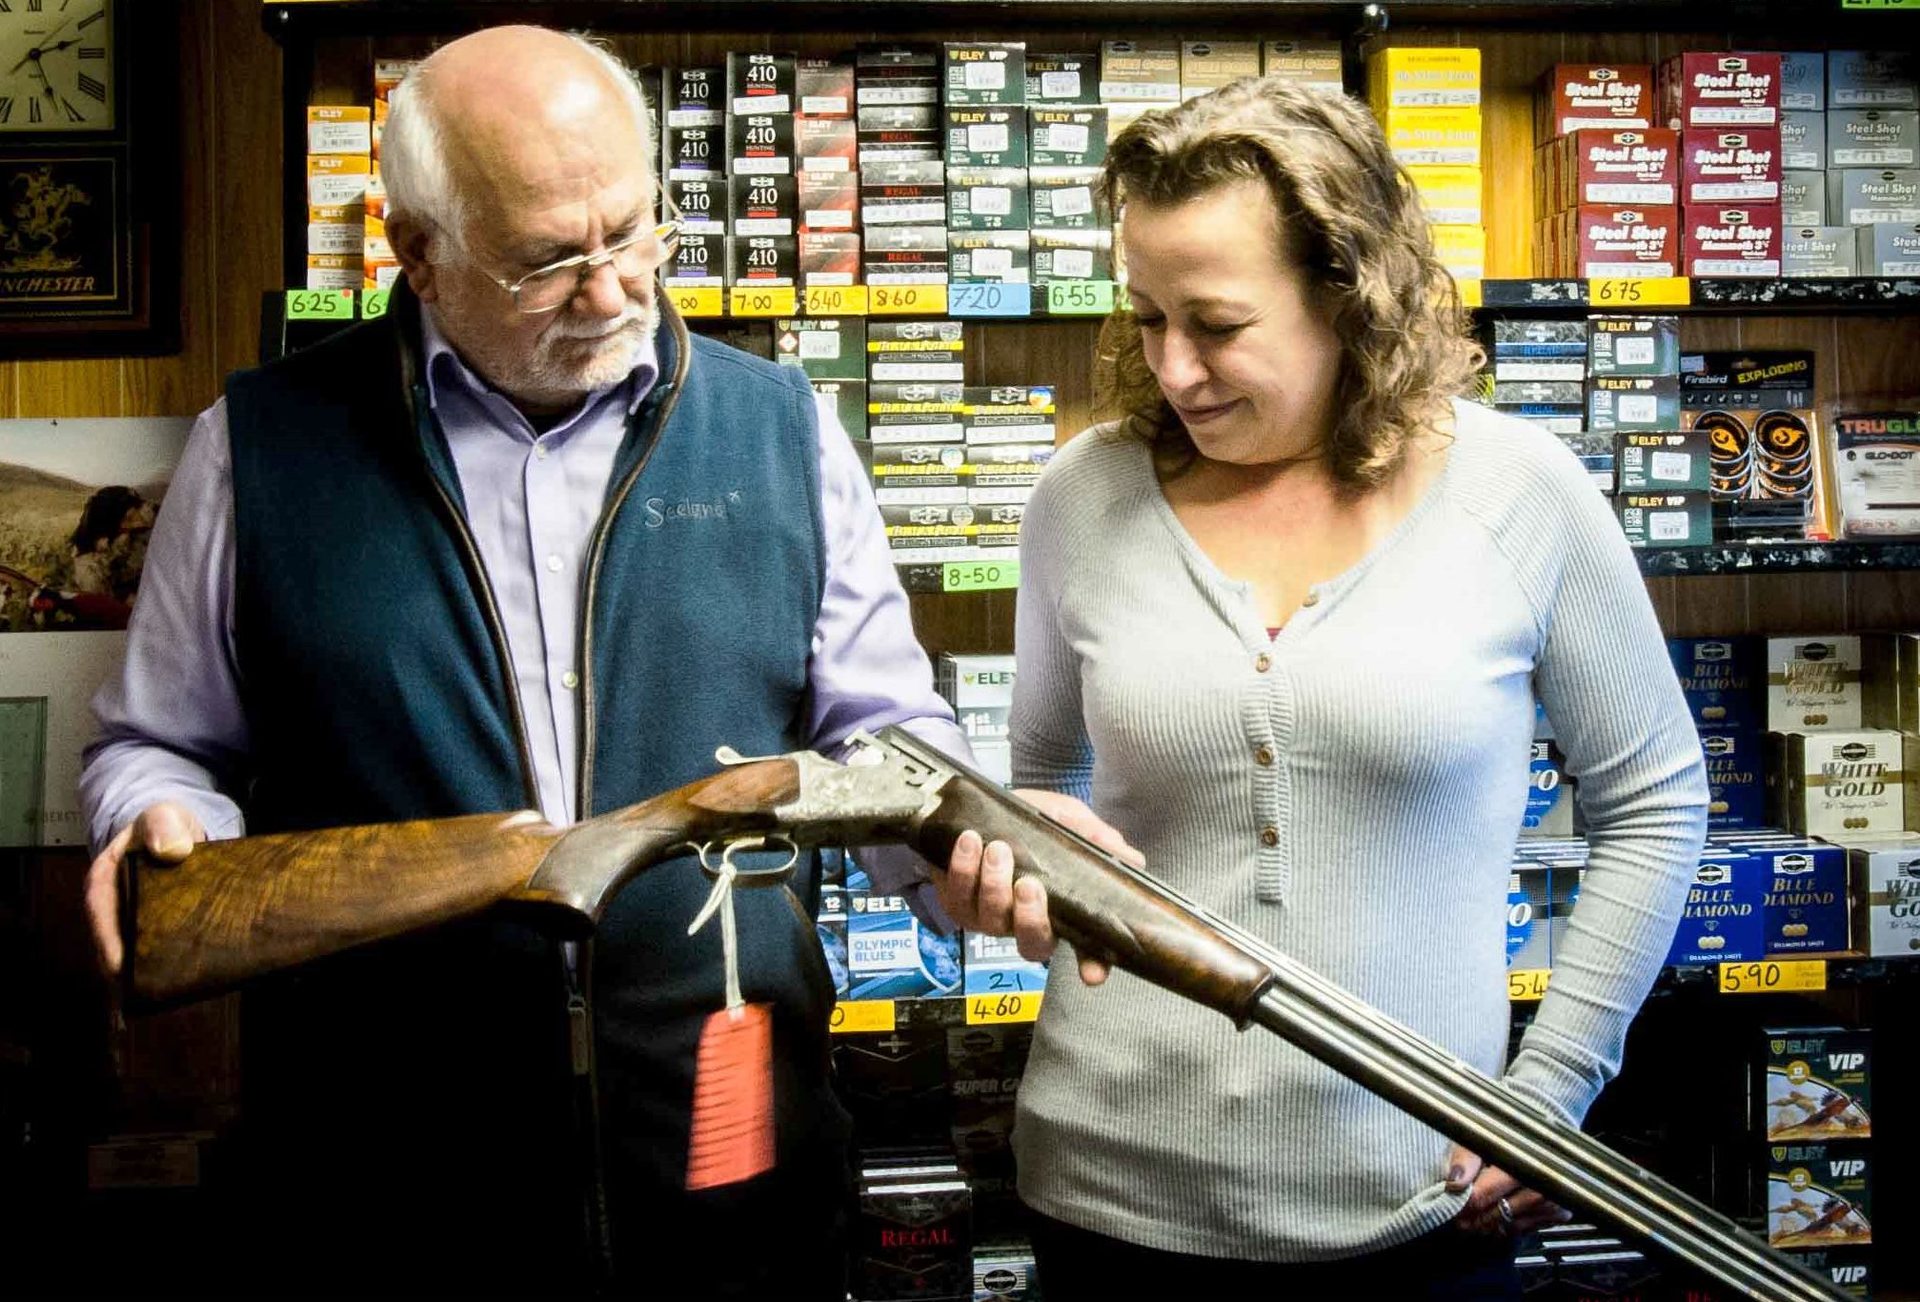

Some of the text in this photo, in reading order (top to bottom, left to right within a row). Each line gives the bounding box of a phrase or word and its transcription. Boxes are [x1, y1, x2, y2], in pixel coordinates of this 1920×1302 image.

[960, 51, 1008, 60] ELEY VIP
[1035, 63, 1081, 71] ELEY VIP
[1694, 73, 1771, 87] Steel Shot
[1565, 82, 1642, 97] Steel Shot
[961, 113, 1009, 122] ELEY VIP
[1045, 113, 1092, 122] ELEY VIP
[1782, 125, 1806, 135] Shot
[1846, 123, 1901, 133] Steel Shot
[1589, 147, 1668, 162] Steel Shot
[1695, 150, 1772, 164] Steel Shot
[884, 187, 921, 197] REGAL
[1782, 184, 1806, 194] Shot
[1861, 184, 1917, 194] Steel Shot
[1588, 225, 1667, 240] Steel Shot
[1695, 226, 1773, 240] Steel Shot
[1811, 241, 1837, 251] Shot
[3, 276, 94, 292] NCHESTER
[1608, 322, 1653, 331] ELEY VIP
[1736, 360, 1807, 385] EXPLODING
[1608, 380, 1653, 389] ELEY VIP
[1685, 375, 1728, 385] Firebird
[820, 384, 839, 393] VIP
[1638, 436, 1685, 446] ELEY VIP
[1638, 497, 1685, 506] ELEY VIP
[977, 672, 1016, 685] ELE
[1708, 759, 1736, 771] LUE
[1822, 762, 1888, 778] WHITE
[1823, 781, 1885, 798] GOLD
[1773, 878, 1817, 892] BLUE
[1689, 889, 1734, 903] BLUE
[1684, 904, 1752, 918] IAMOND
[854, 938, 912, 951] OLYMPIC
[855, 950, 896, 962] BLUES
[1828, 1054, 1864, 1070] VIP
[953, 1079, 998, 1095] SUPER
[1829, 1160, 1865, 1177] VIP
[881, 1229, 954, 1247] REGAL
[1832, 1266, 1867, 1283] VIP
